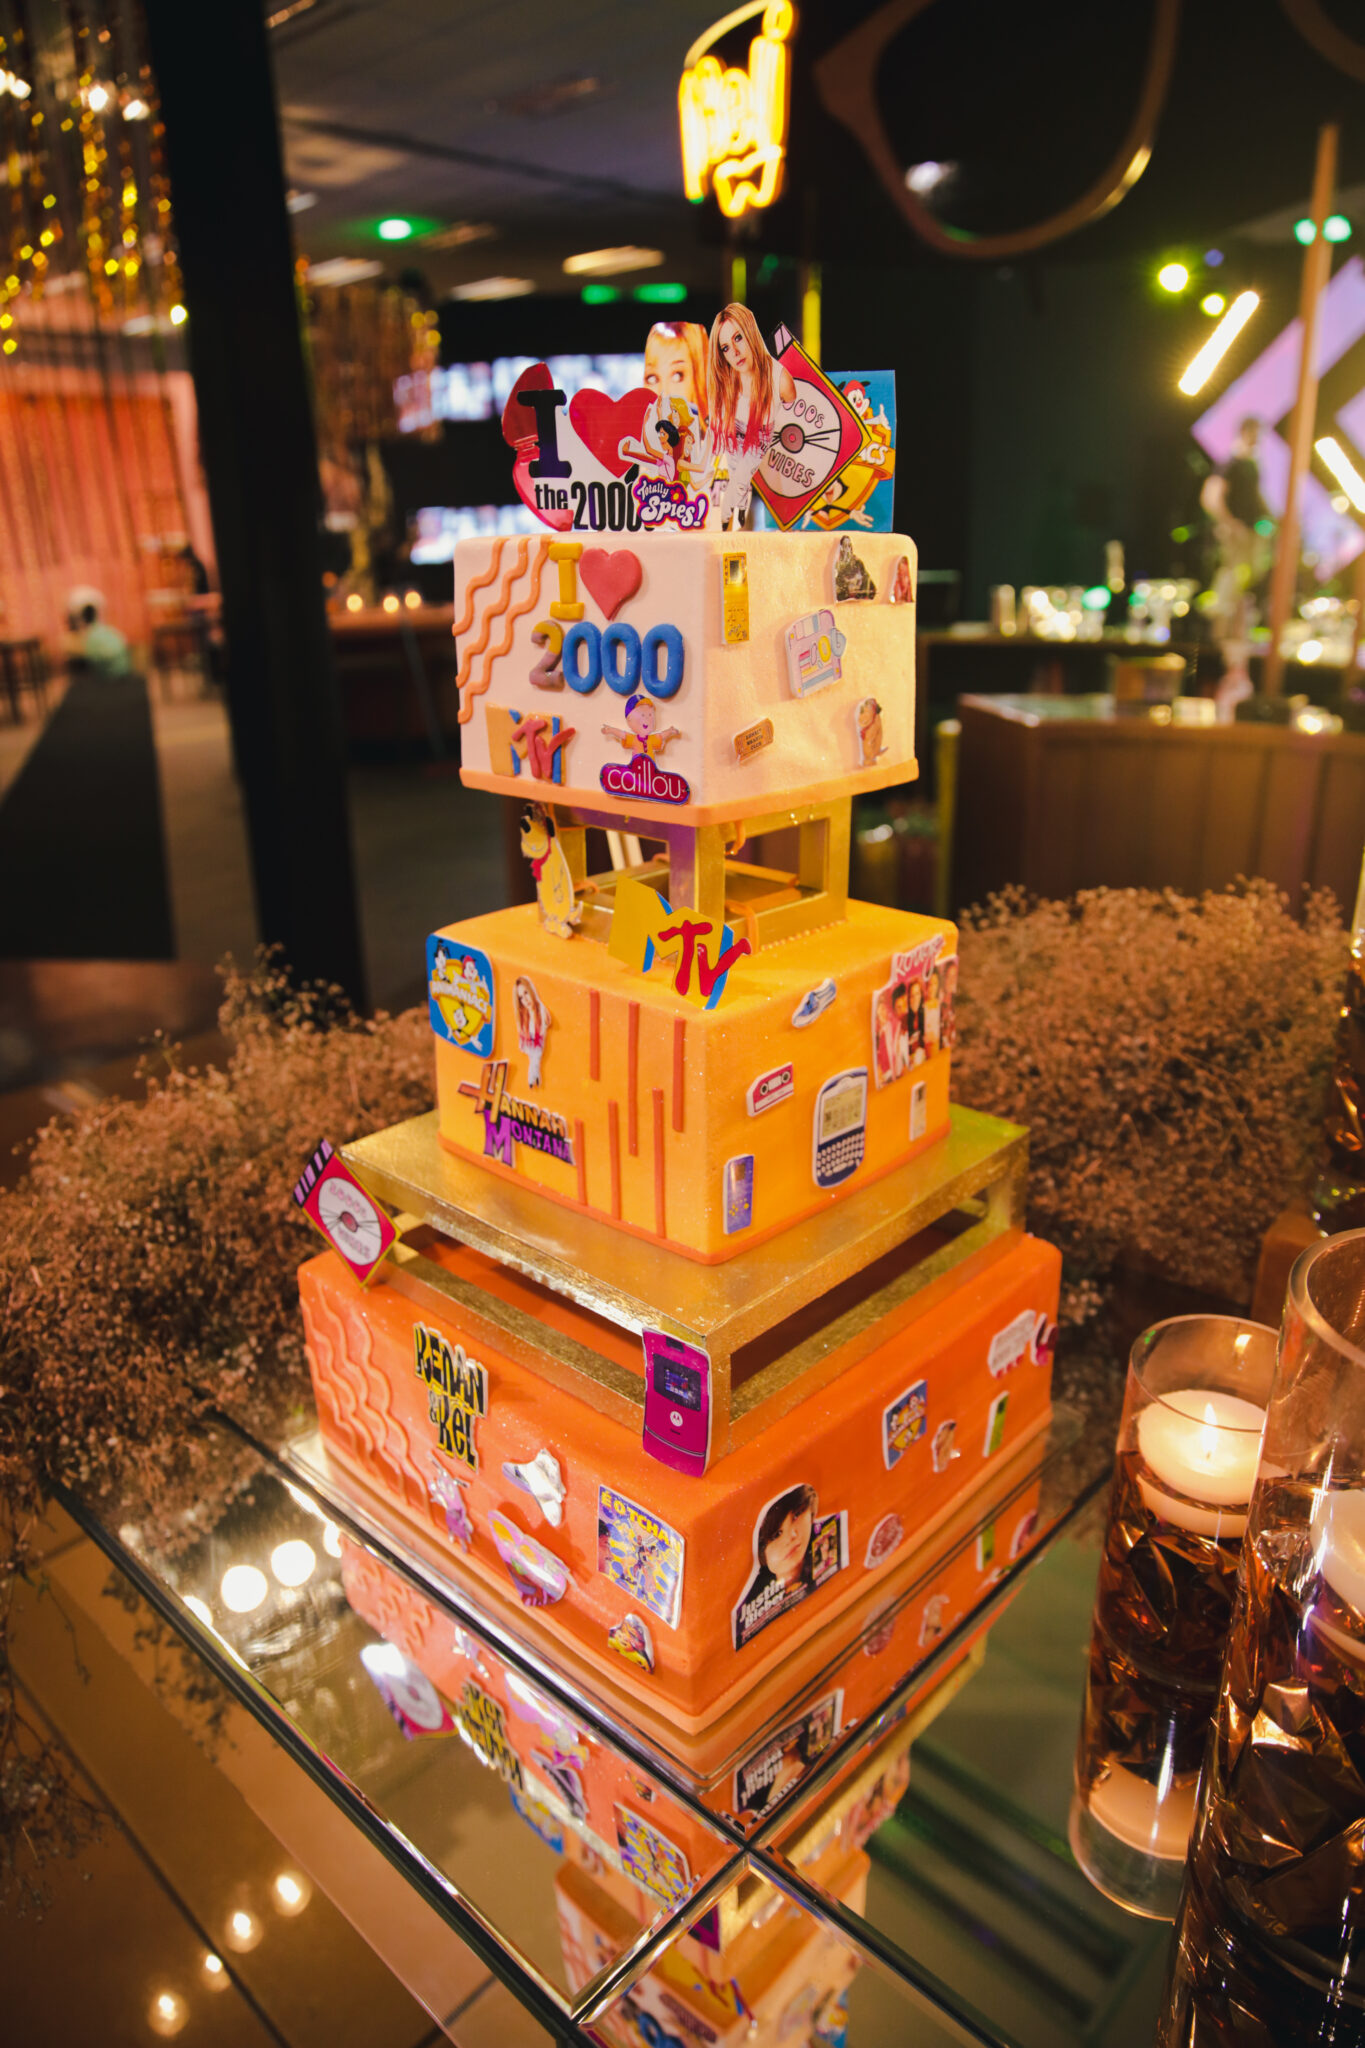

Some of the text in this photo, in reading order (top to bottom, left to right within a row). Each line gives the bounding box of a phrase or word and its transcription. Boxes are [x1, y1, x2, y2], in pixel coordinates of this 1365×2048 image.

[517, 389, 572, 478] I
[637, 480, 670, 500] Totally
[768, 448, 815, 488] VIBES
[535, 481, 655, 532] the 2000
[641, 497, 707, 527] Spies!
[548, 543, 585, 621] I
[529, 619, 685, 698] 2000
[608, 760, 682, 799] caillou
[608, 873, 752, 1010] MTV
[457, 1061, 568, 1139] HANNAH
[483, 1109, 576, 1168] MONTANA
[614, 1500, 626, 1516] O
[740, 1578, 786, 1622] Justin
